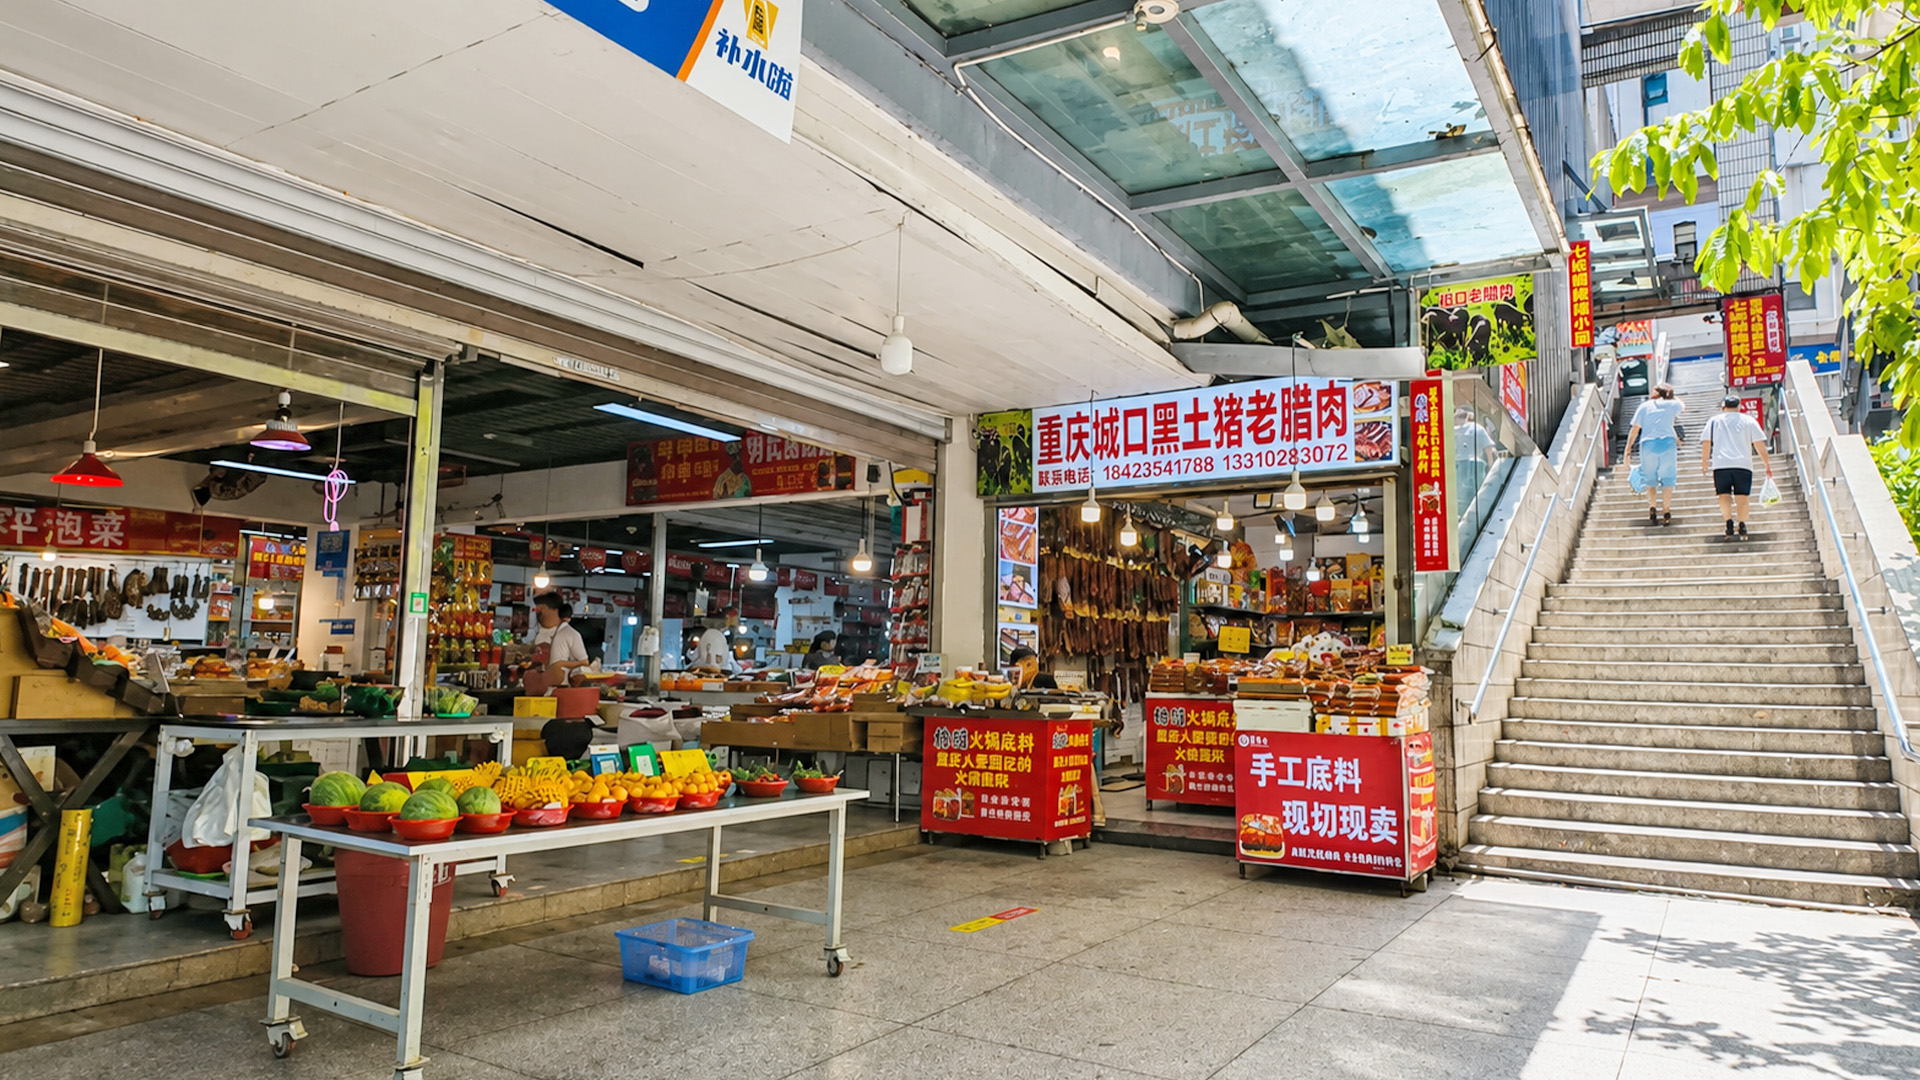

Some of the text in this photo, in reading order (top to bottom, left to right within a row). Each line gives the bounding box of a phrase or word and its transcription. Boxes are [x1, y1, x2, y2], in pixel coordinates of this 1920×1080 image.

[716, 28, 793, 101] 补水啦
[1037, 380, 1347, 466] 重庆城口黑土猪老腊肉
[1103, 457, 1214, 481] 18423541788
[1222, 443, 1347, 472] 13310283072
[1250, 752, 1362, 794] 手工底料
[1281, 800, 1398, 845] 现切现卖
